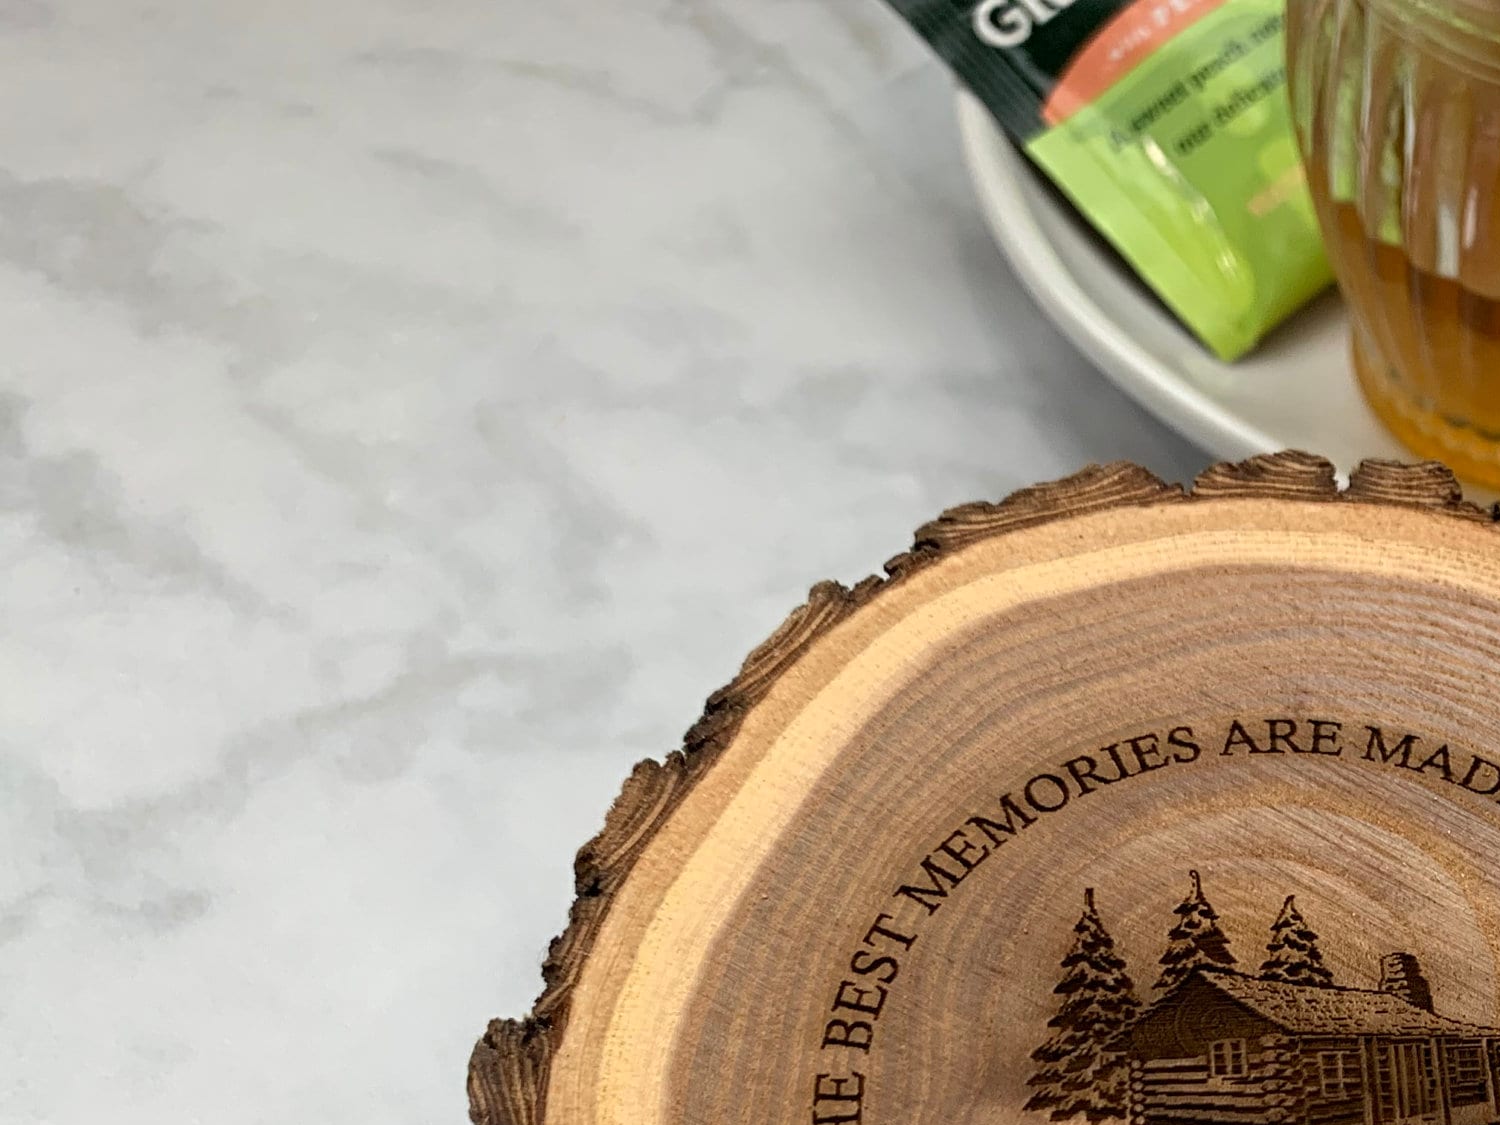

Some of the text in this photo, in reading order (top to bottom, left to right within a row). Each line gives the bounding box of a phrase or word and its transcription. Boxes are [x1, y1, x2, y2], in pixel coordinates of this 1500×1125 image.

[821, 913, 918, 1055] BEST
[893, 726, 1202, 916] MEMORIES
[1219, 718, 1342, 757] ARE
